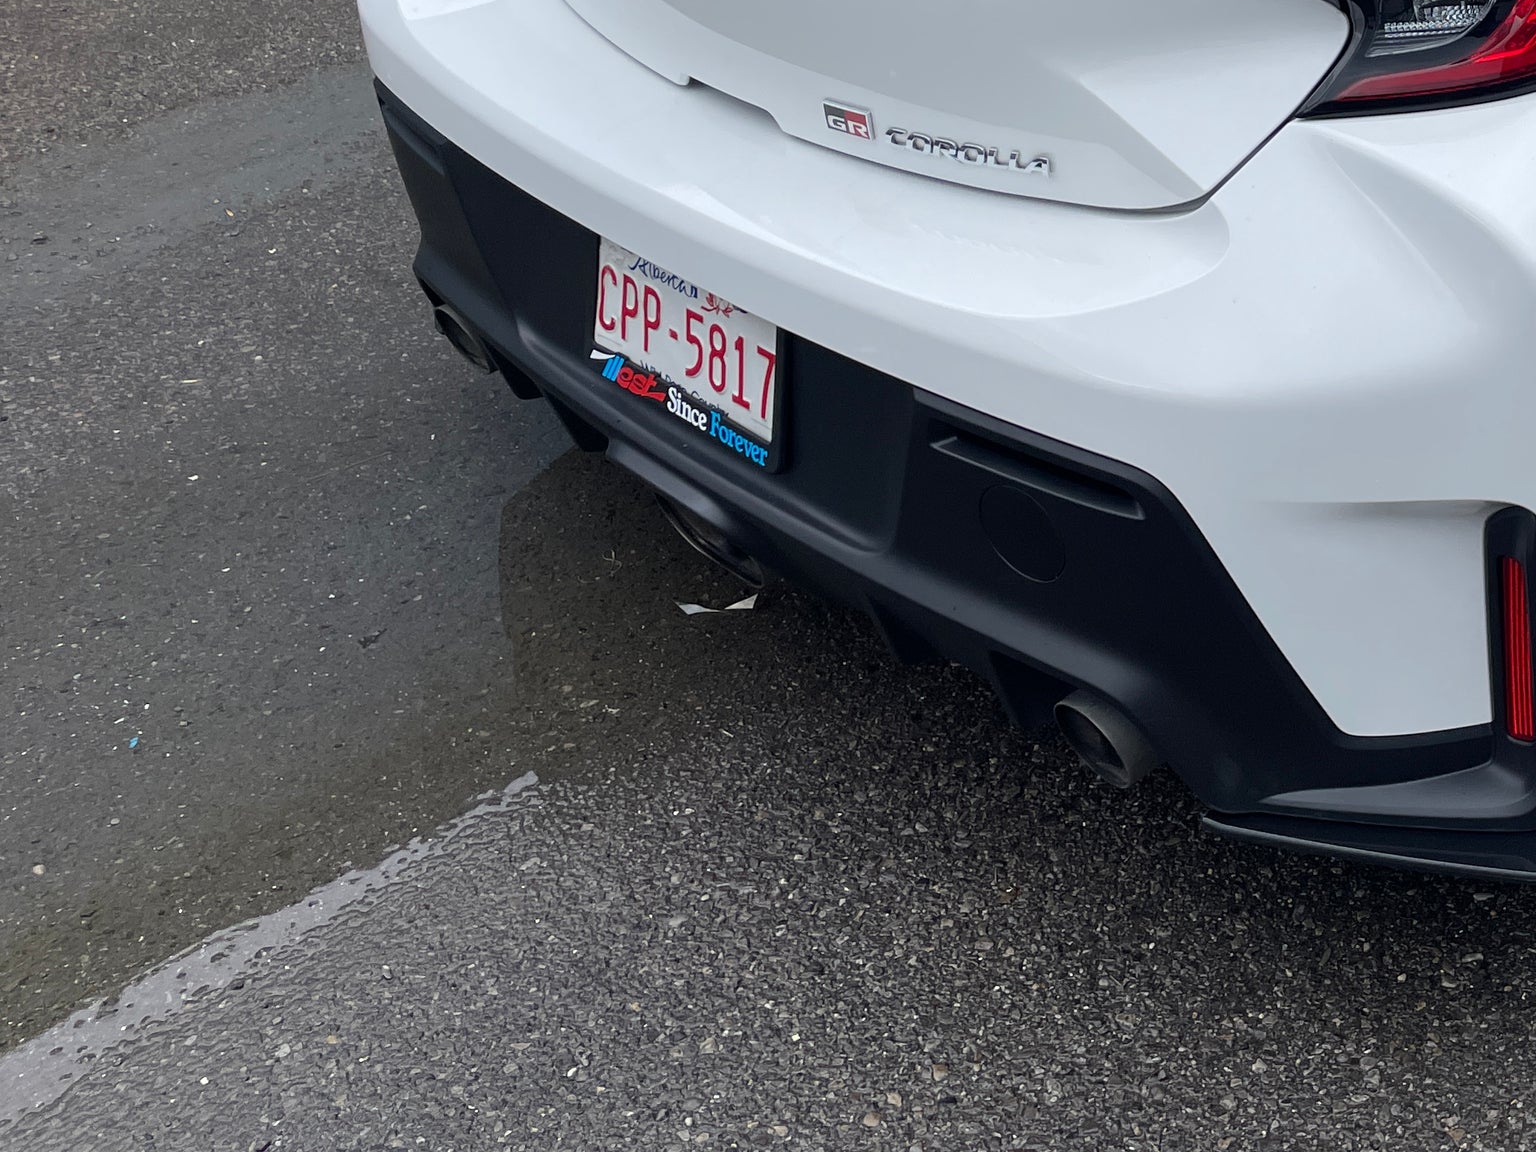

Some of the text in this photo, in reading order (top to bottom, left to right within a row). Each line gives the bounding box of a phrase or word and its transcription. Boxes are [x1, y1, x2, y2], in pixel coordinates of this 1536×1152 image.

[827, 114, 1052, 179] GR COROLLA
[598, 264, 776, 420] CPP-5817
[666, 386, 708, 432] Since
[708, 409, 769, 467] Forever
